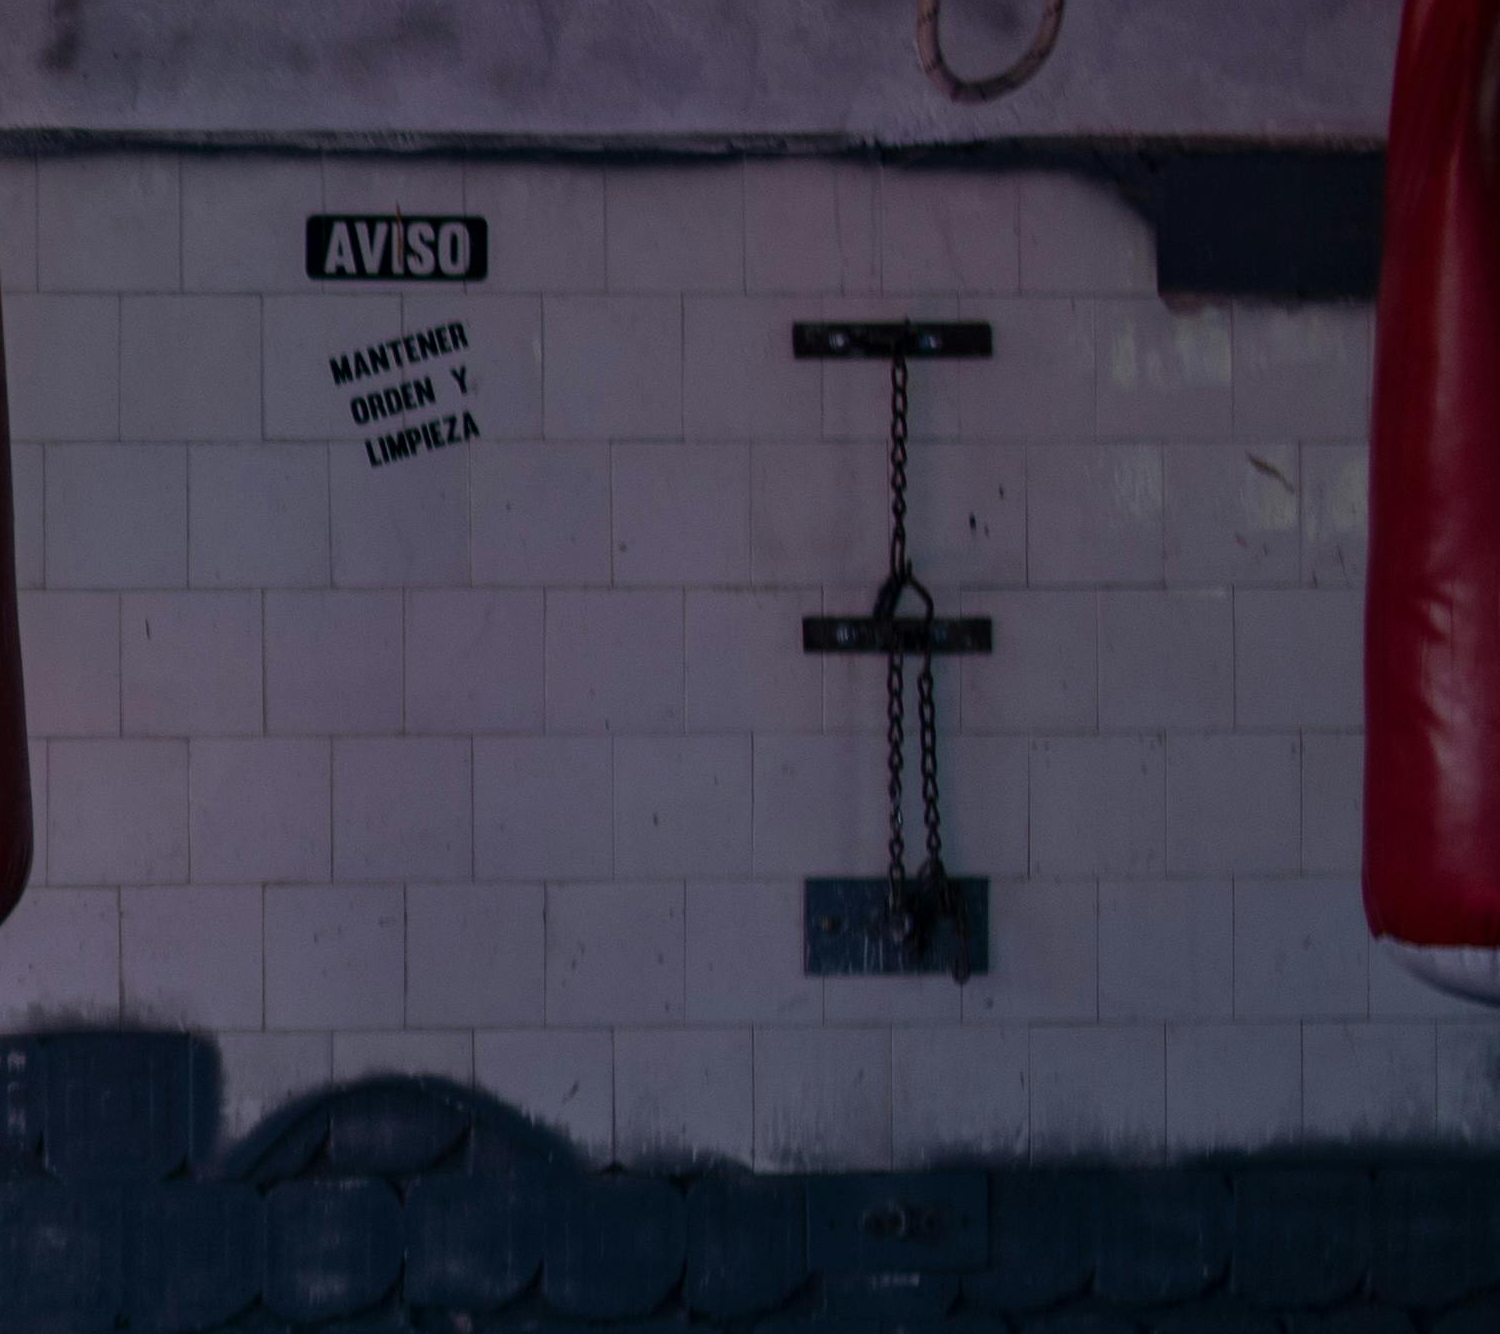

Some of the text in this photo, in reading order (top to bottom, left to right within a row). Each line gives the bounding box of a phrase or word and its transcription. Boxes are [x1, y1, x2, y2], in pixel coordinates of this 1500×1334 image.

[324, 221, 471, 276] AVISO
[329, 322, 469, 385] MANTENER
[350, 365, 469, 426] ORDEN Y
[364, 410, 481, 468] LIMPIEZA
